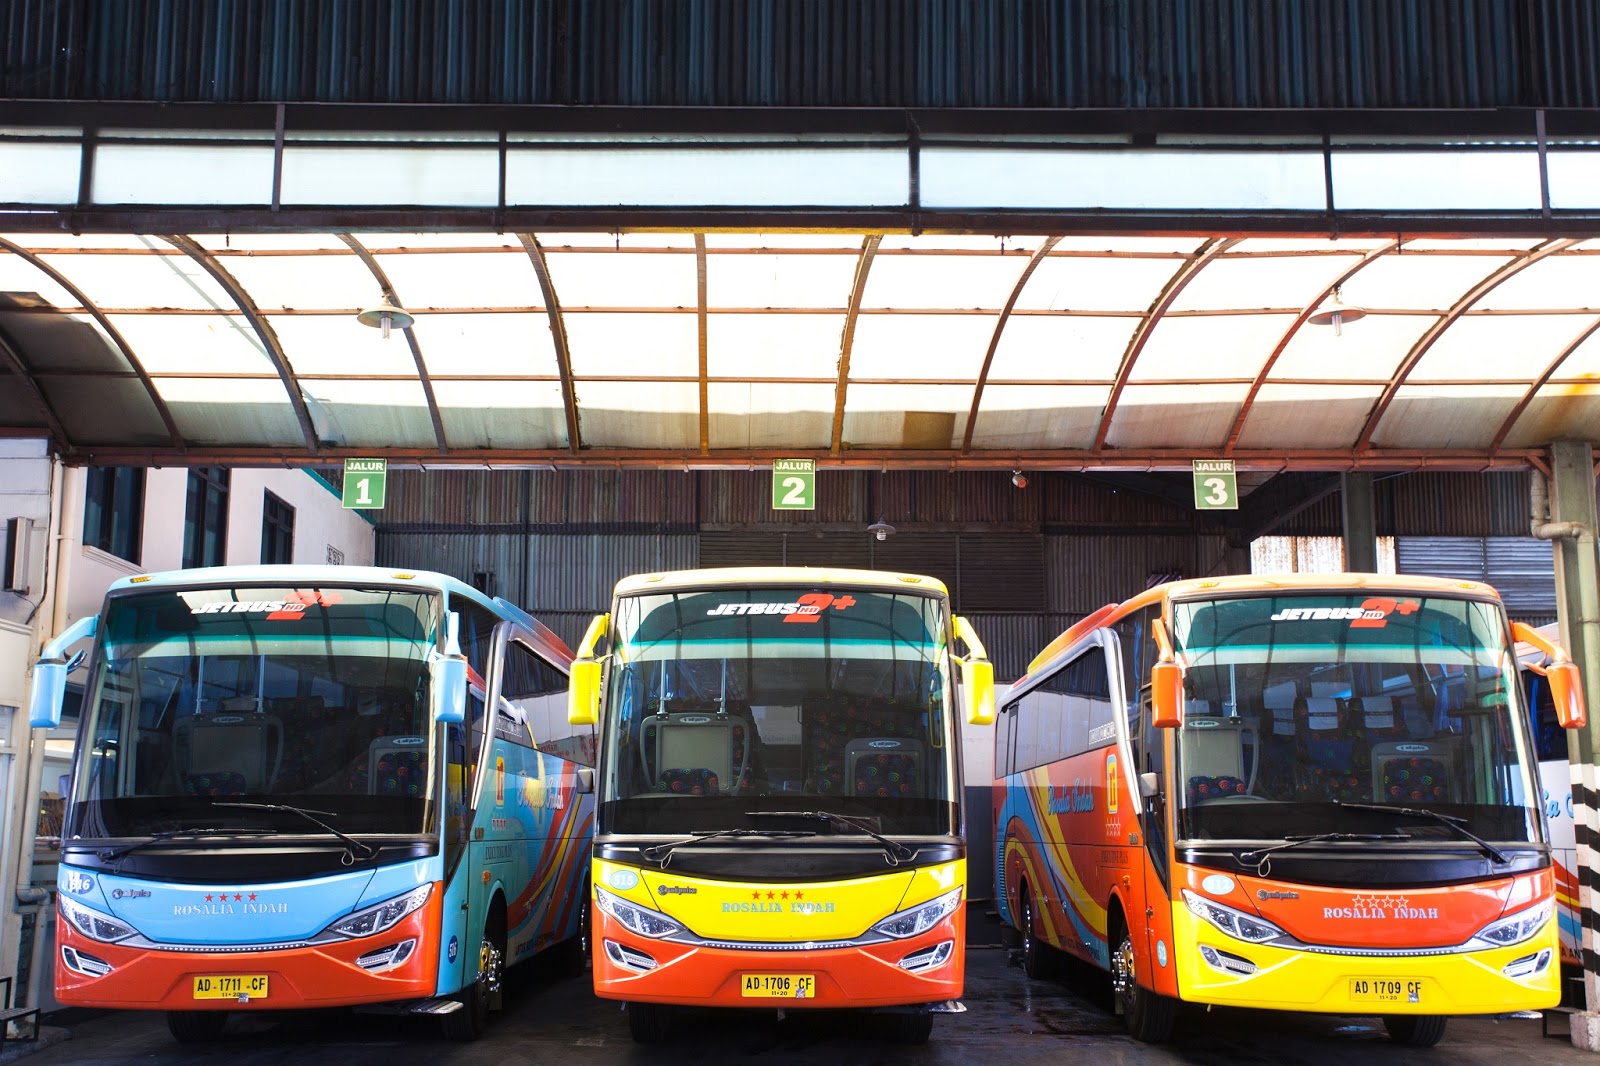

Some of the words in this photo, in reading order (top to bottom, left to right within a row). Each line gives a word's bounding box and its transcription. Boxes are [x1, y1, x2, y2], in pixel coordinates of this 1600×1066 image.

[347, 462, 384, 470] JALUR
[776, 462, 812, 470] JALUR
[1195, 463, 1232, 471] JALUR
[356, 478, 372, 504] 1
[781, 476, 806, 505] 2
[1203, 477, 1228, 505] 3
[191, 601, 287, 614] JETBUS
[707, 603, 800, 615] JETBUS
[1271, 608, 1365, 620] JETBUS
[614, 874, 634, 885] 515
[173, 904, 234, 916] ROSALIA
[243, 902, 288, 914] INDAH
[721, 902, 783, 913] ROSALIA
[790, 902, 835, 913] INDAH
[1323, 907, 1386, 919] ROSALIA
[1393, 907, 1438, 919] INDAH
[197, 979, 211, 992] AD
[219, 978, 241, 991] 1711
[251, 977, 266, 990] CF
[746, 977, 760, 989] AD
[765, 977, 790, 990] 1706
[798, 977, 812, 990] CF
[1355, 981, 1369, 993] AD
[1373, 981, 1401, 994] 1709
[1408, 981, 1421, 994] CF
